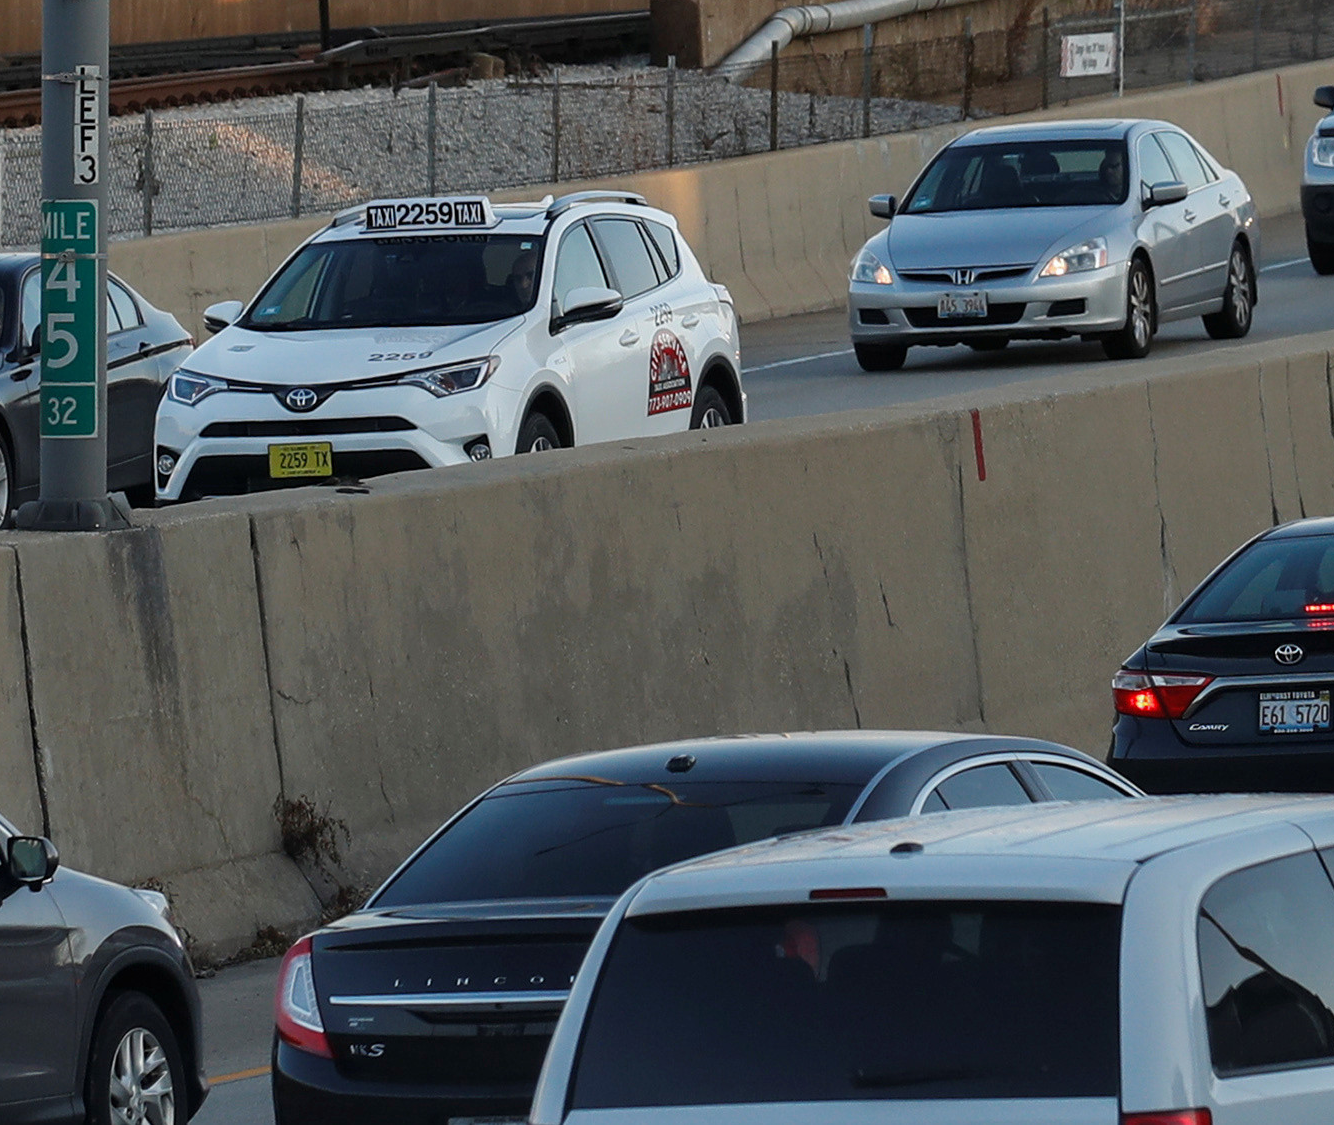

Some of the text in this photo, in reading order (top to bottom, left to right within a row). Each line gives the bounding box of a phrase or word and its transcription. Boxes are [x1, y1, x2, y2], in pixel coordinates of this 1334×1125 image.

[41, 211, 91, 241] MILE
[369, 202, 482, 227] TAXI 2259 TAXI
[47, 396, 78, 426] 32
[649, 390, 692, 411] 773-907-0909
[279, 450, 329, 469] 2259 TX
[1261, 703, 1329, 726] E61 5720
